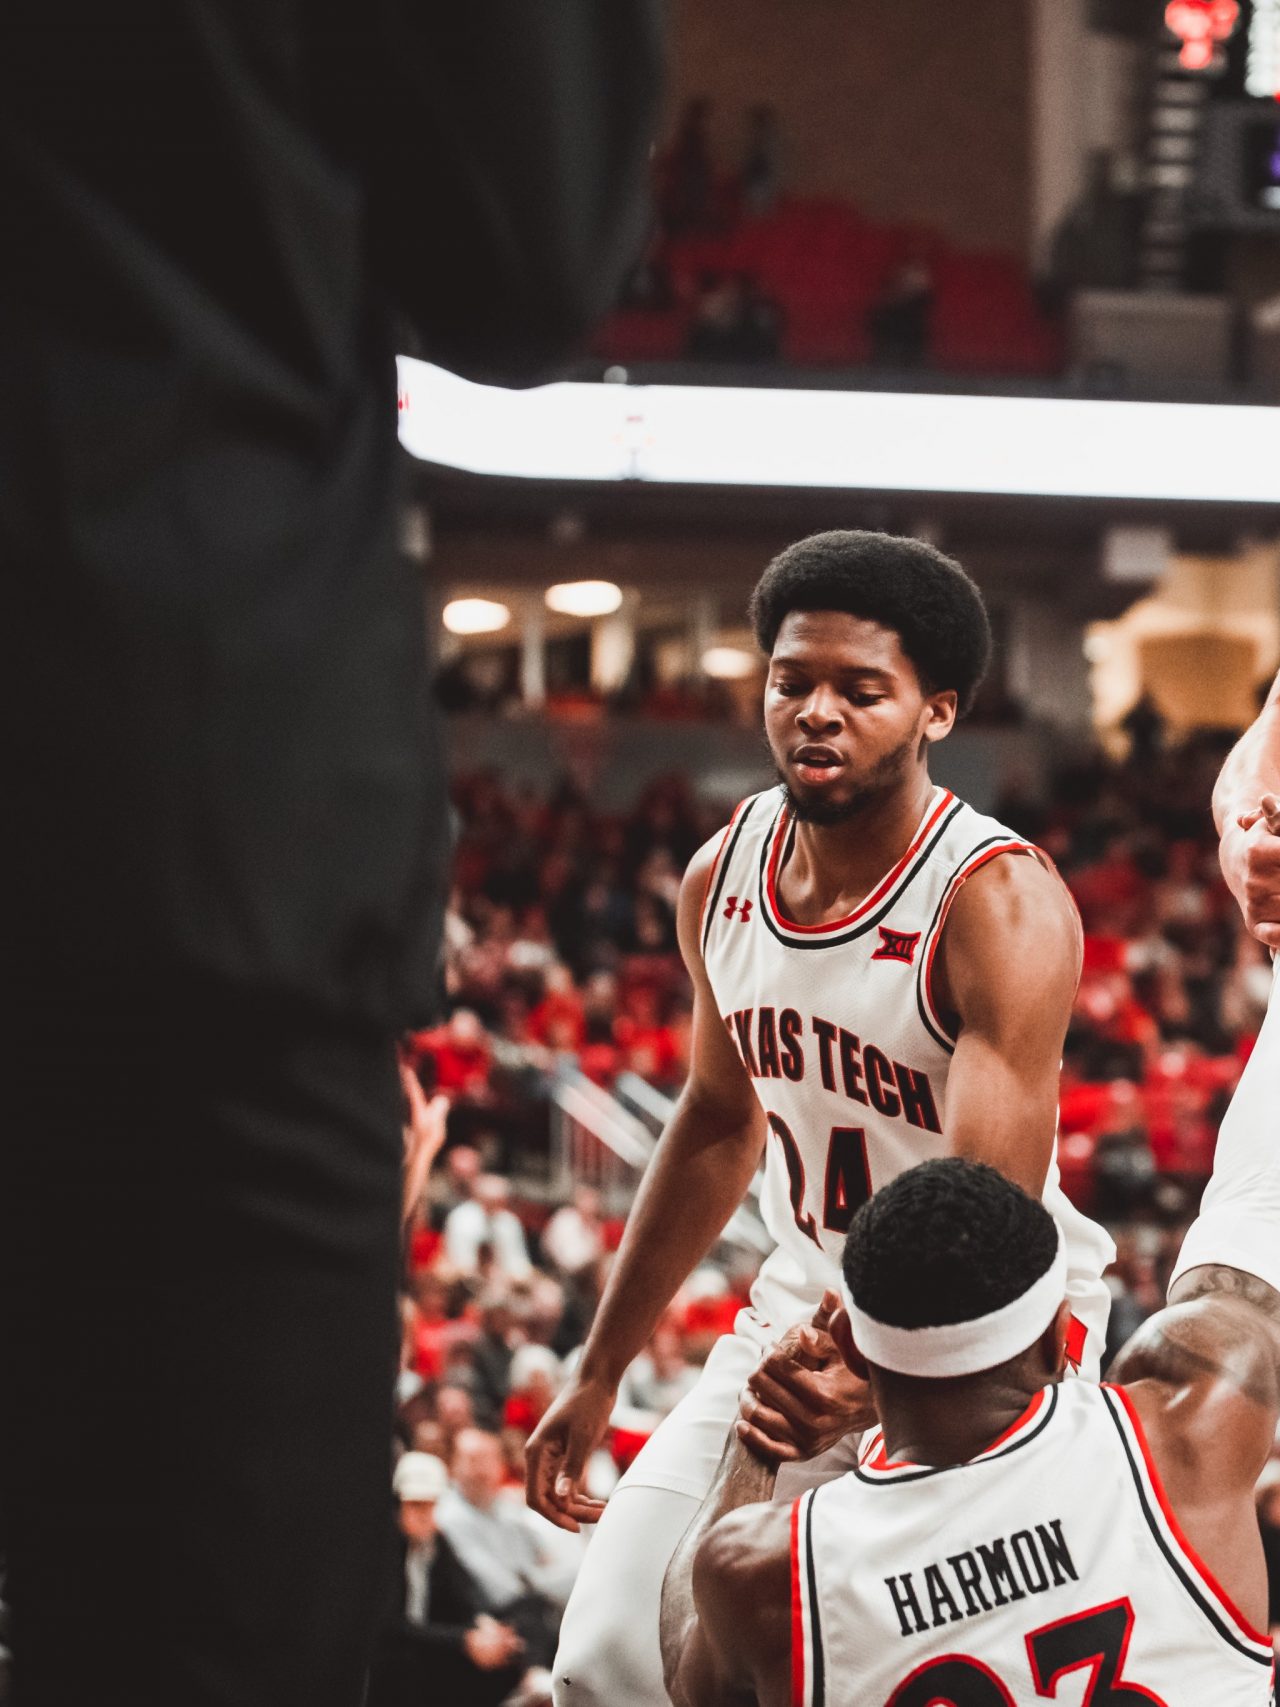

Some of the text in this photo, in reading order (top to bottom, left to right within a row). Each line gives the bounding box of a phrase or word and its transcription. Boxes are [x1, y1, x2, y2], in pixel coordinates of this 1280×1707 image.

[724, 1007, 943, 1135] XAS TECH
[884, 1519, 1079, 1637] HARMON
